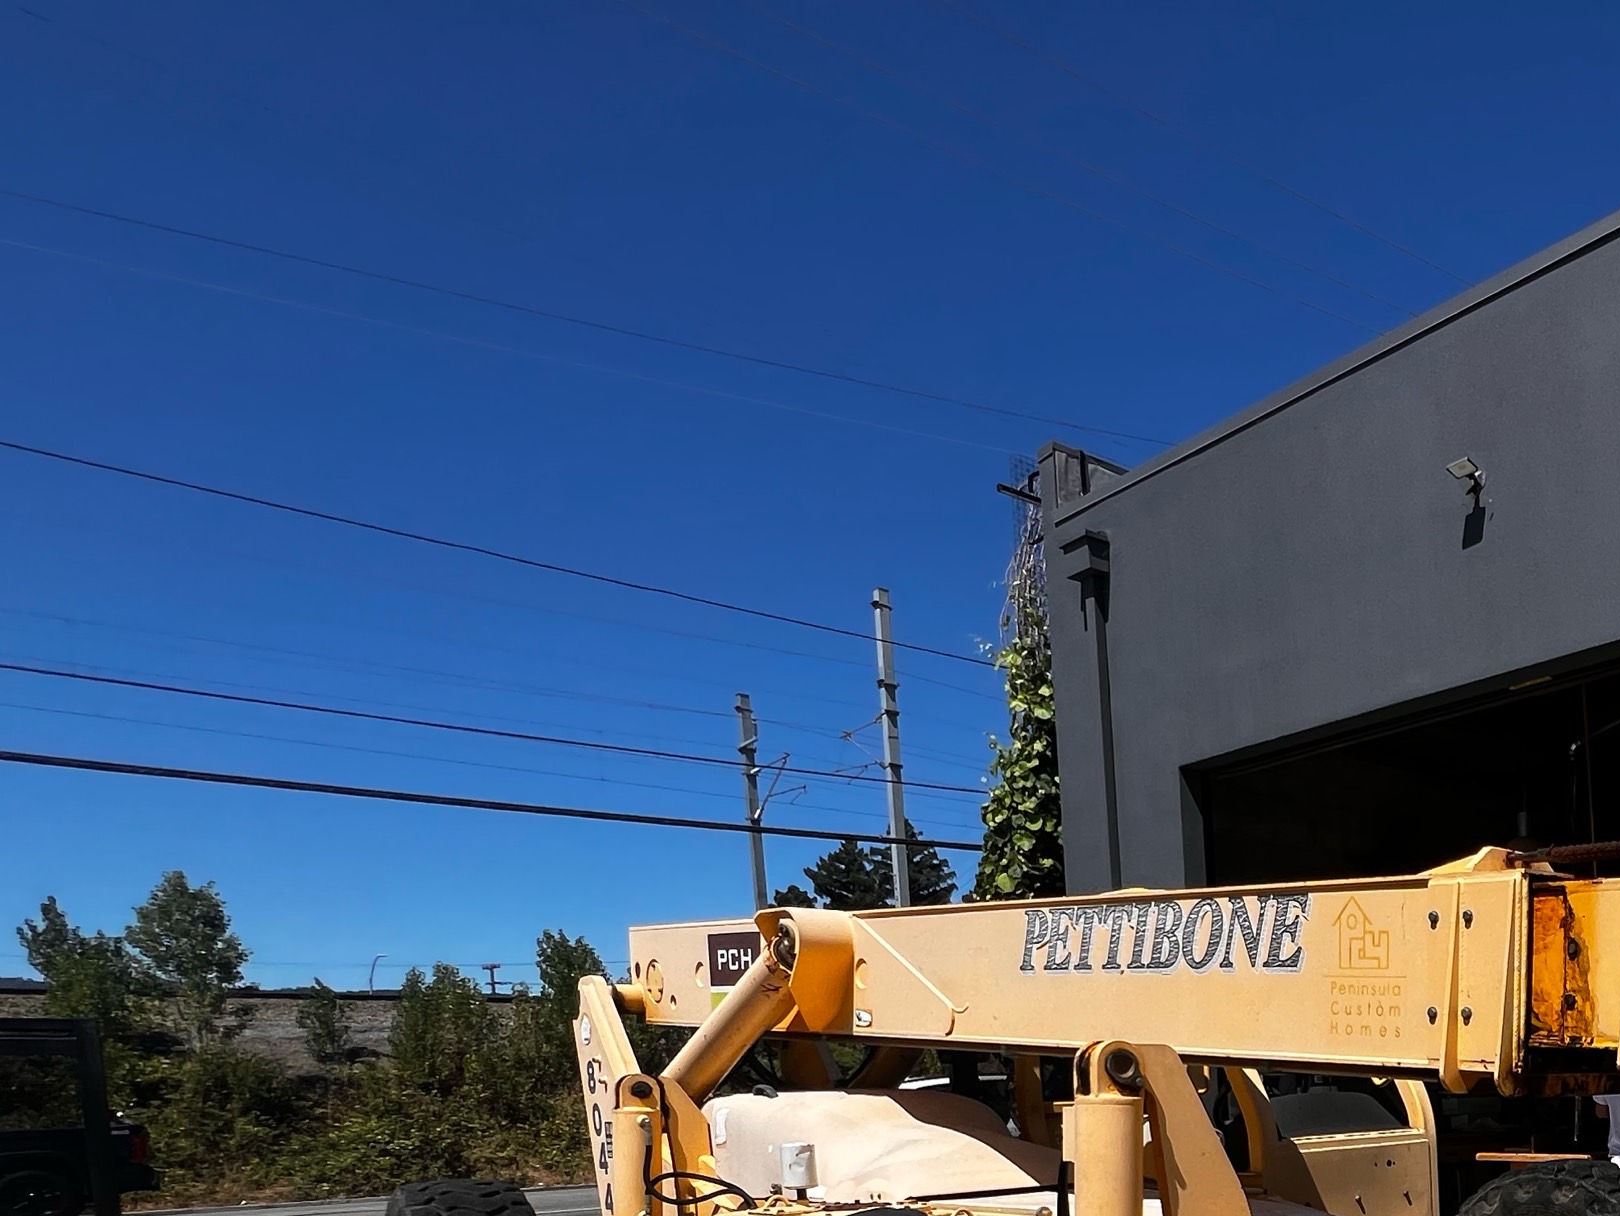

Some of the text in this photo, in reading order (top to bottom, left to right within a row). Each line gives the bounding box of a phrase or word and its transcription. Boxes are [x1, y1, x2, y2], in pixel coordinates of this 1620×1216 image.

[1019, 893, 1312, 975] PETTIBONE
[717, 948, 752, 971] PCH
[1330, 981, 1401, 997] Peninsula
[1330, 1001, 1401, 1017] Custom
[1330, 1021, 1401, 1038] Homes
